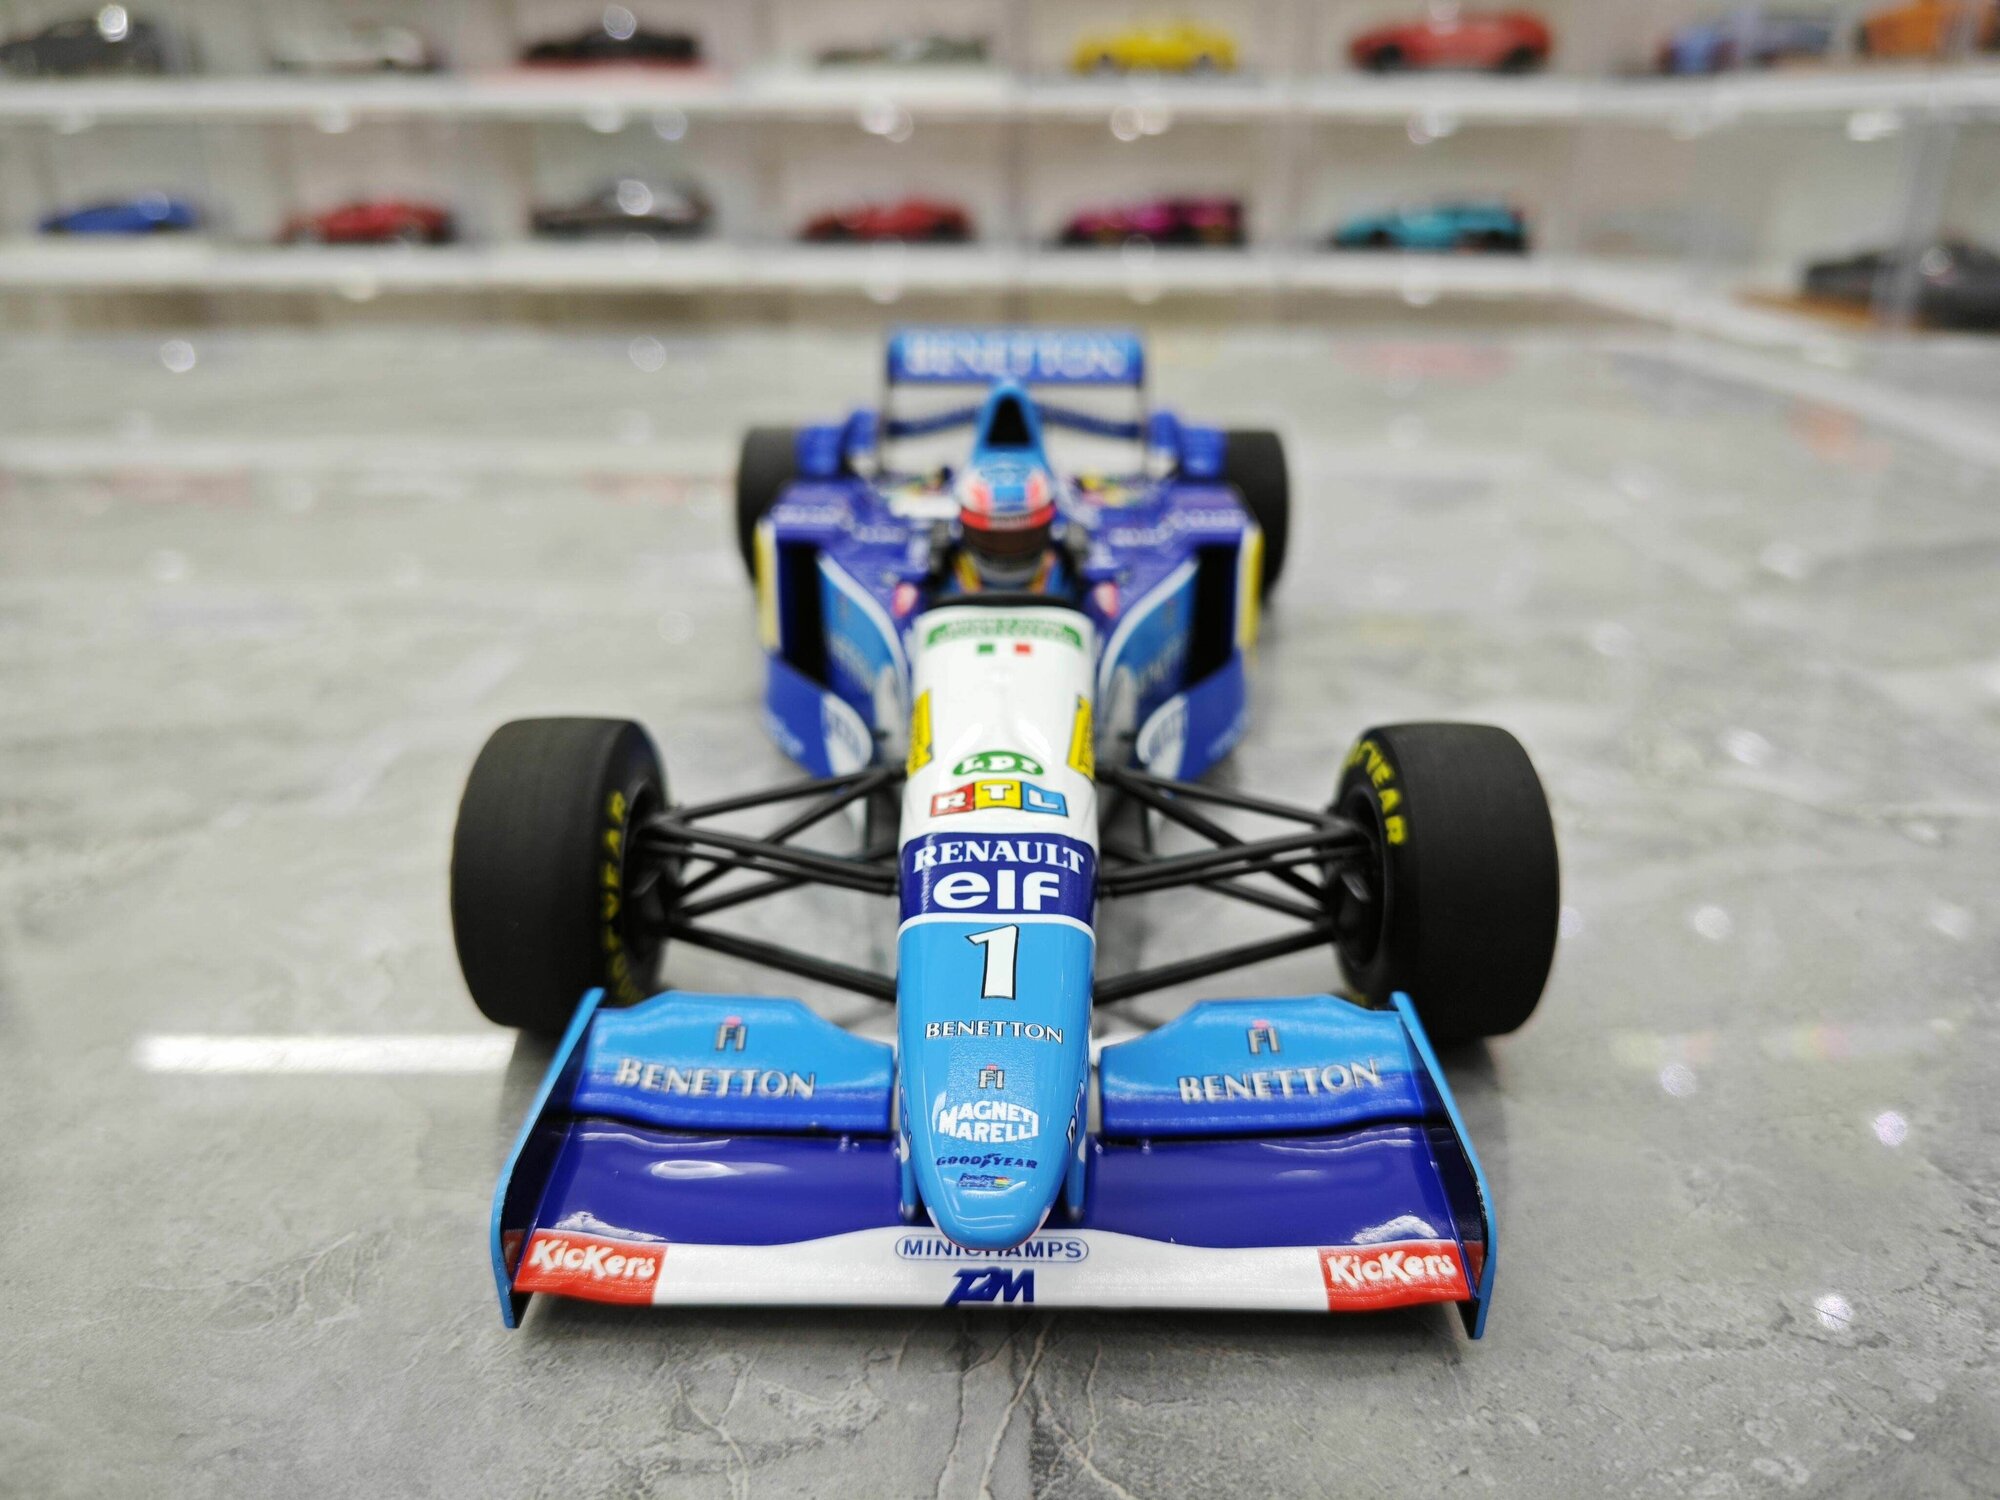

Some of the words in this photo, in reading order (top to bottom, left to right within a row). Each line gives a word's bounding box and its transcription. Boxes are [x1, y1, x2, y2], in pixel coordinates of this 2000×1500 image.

[936, 783, 1061, 810] RTL
[913, 840, 1085, 874] RENAULT
[933, 869, 1060, 911] elf
[965, 923, 1020, 1001] 1
[925, 1020, 1063, 1044] BENETTON
[615, 1058, 816, 1099] BENETTON
[1178, 1058, 1383, 1103] BENETTON
[938, 1114, 1039, 1143] MARELLI
[939, 1100, 1039, 1128] MAGNETI
[936, 1153, 1038, 1169] GOODYEAR
